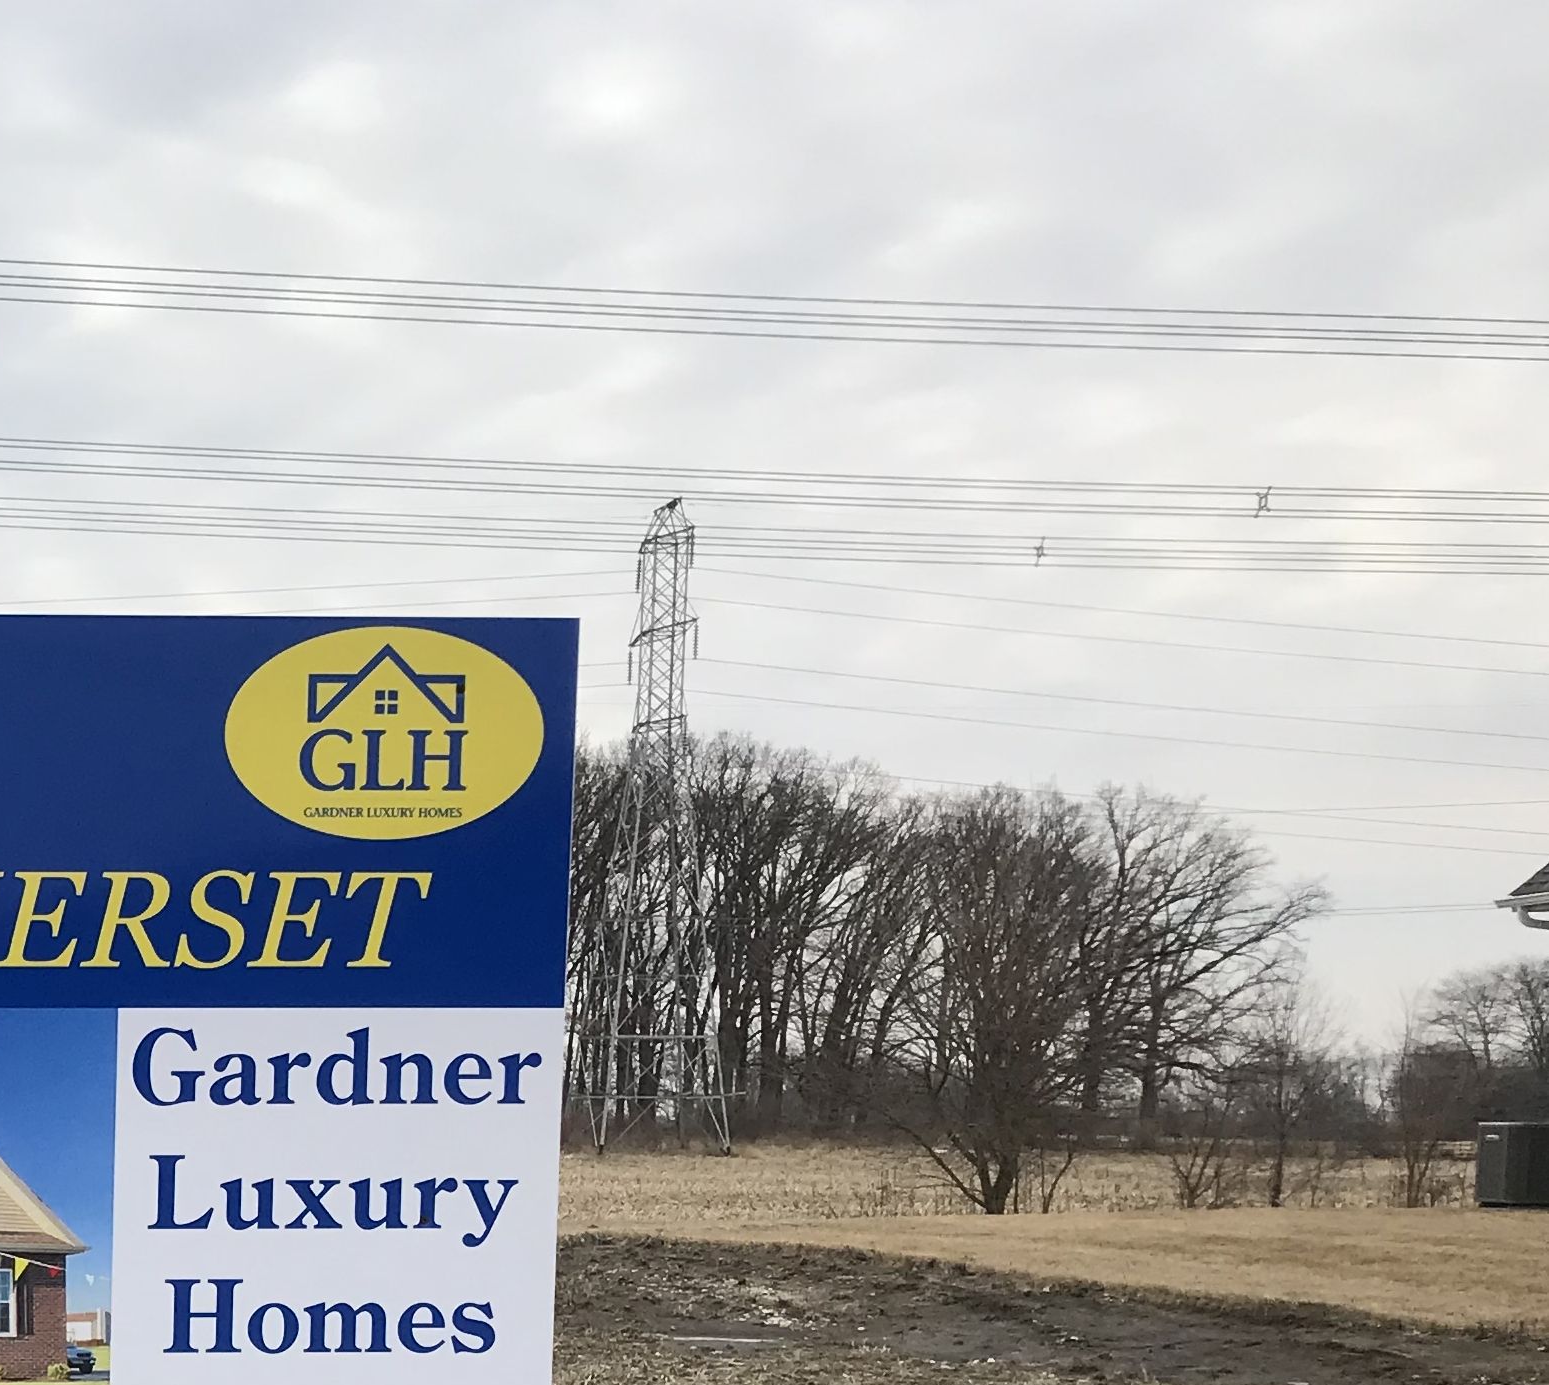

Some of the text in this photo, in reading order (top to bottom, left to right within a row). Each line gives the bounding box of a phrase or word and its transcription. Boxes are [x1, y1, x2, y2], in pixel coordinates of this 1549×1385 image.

[299, 727, 469, 792] GLH
[303, 806, 463, 819] GARDNER LUXURY HOMES
[131, 1026, 543, 1107] Gardner
[147, 1154, 519, 1248] Luxury
[162, 1278, 496, 1354] Homes
